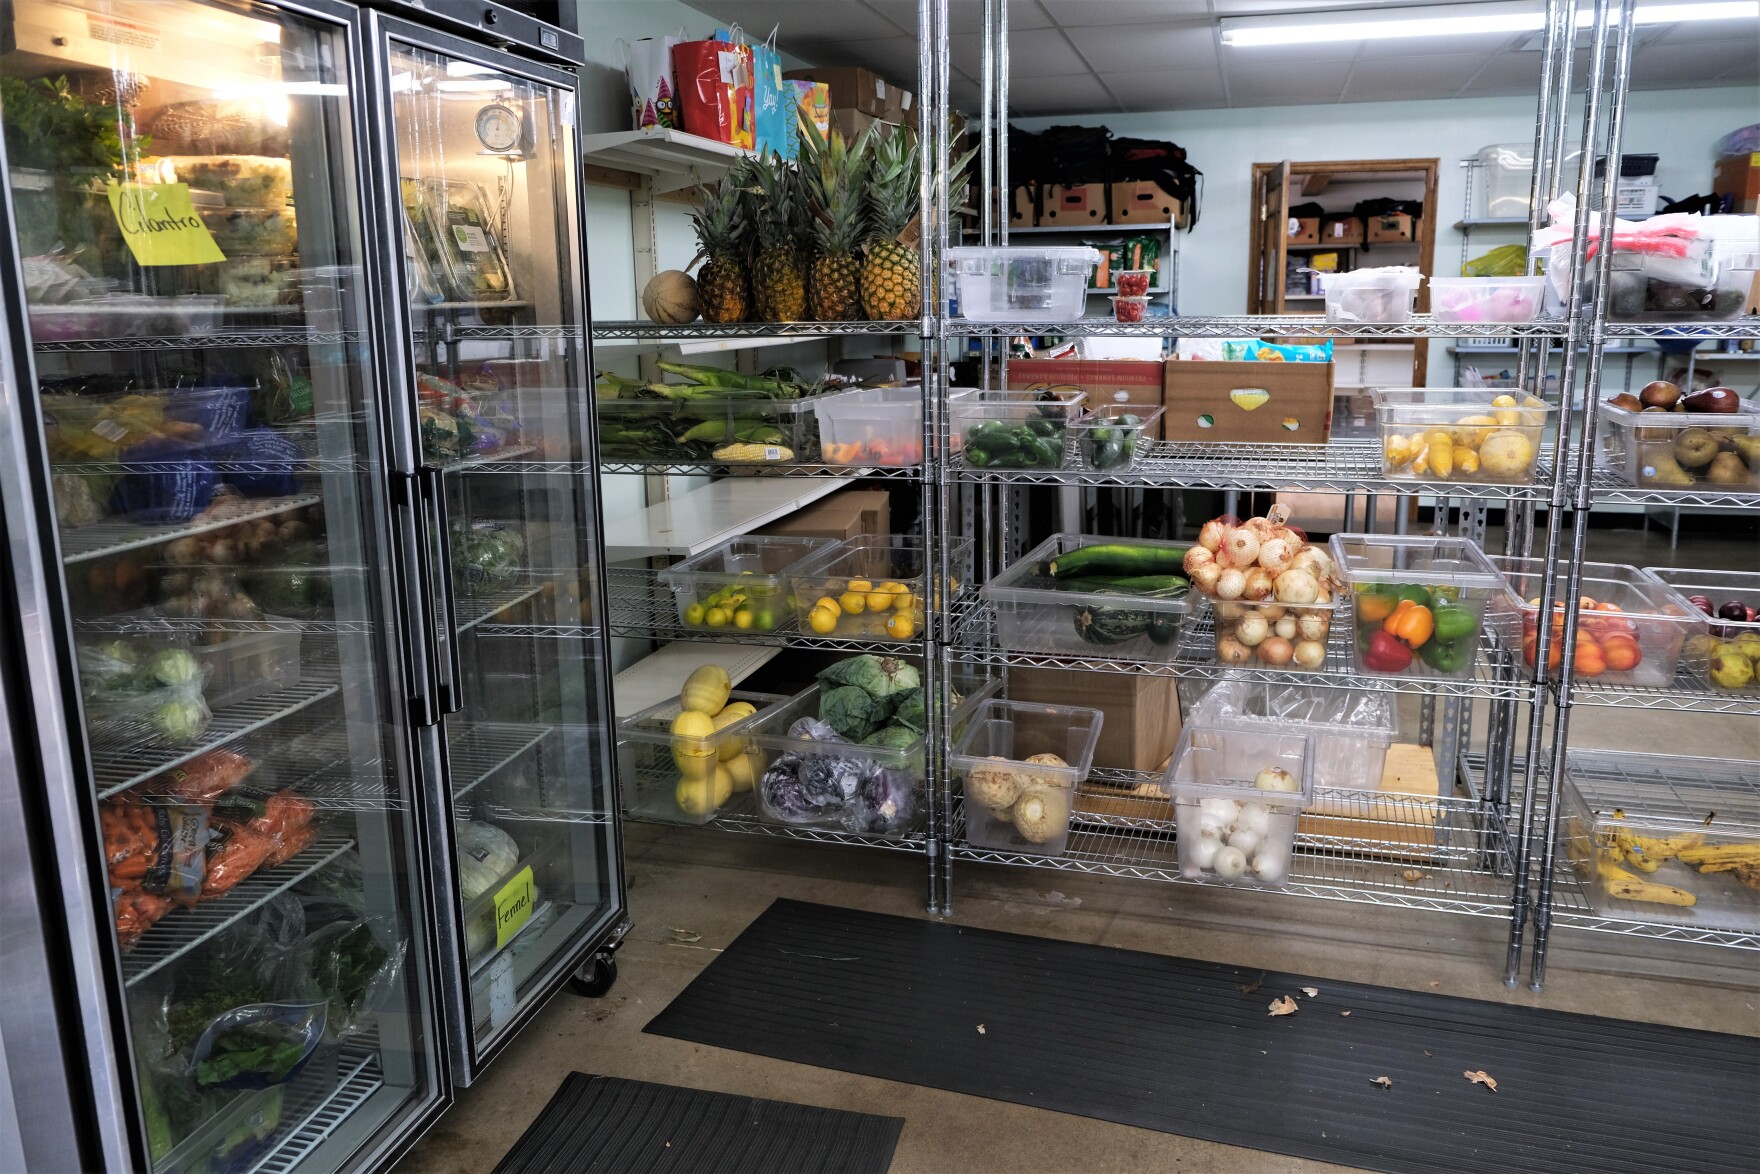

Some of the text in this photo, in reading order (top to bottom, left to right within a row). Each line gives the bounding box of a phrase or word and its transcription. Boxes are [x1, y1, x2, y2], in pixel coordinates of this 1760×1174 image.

[763, 85, 779, 115] Yay!
[119, 191, 200, 235] Cilantro
[1085, 373, 1147, 383] PREMIUM BANANAS
[498, 881, 530, 930] Fennel
